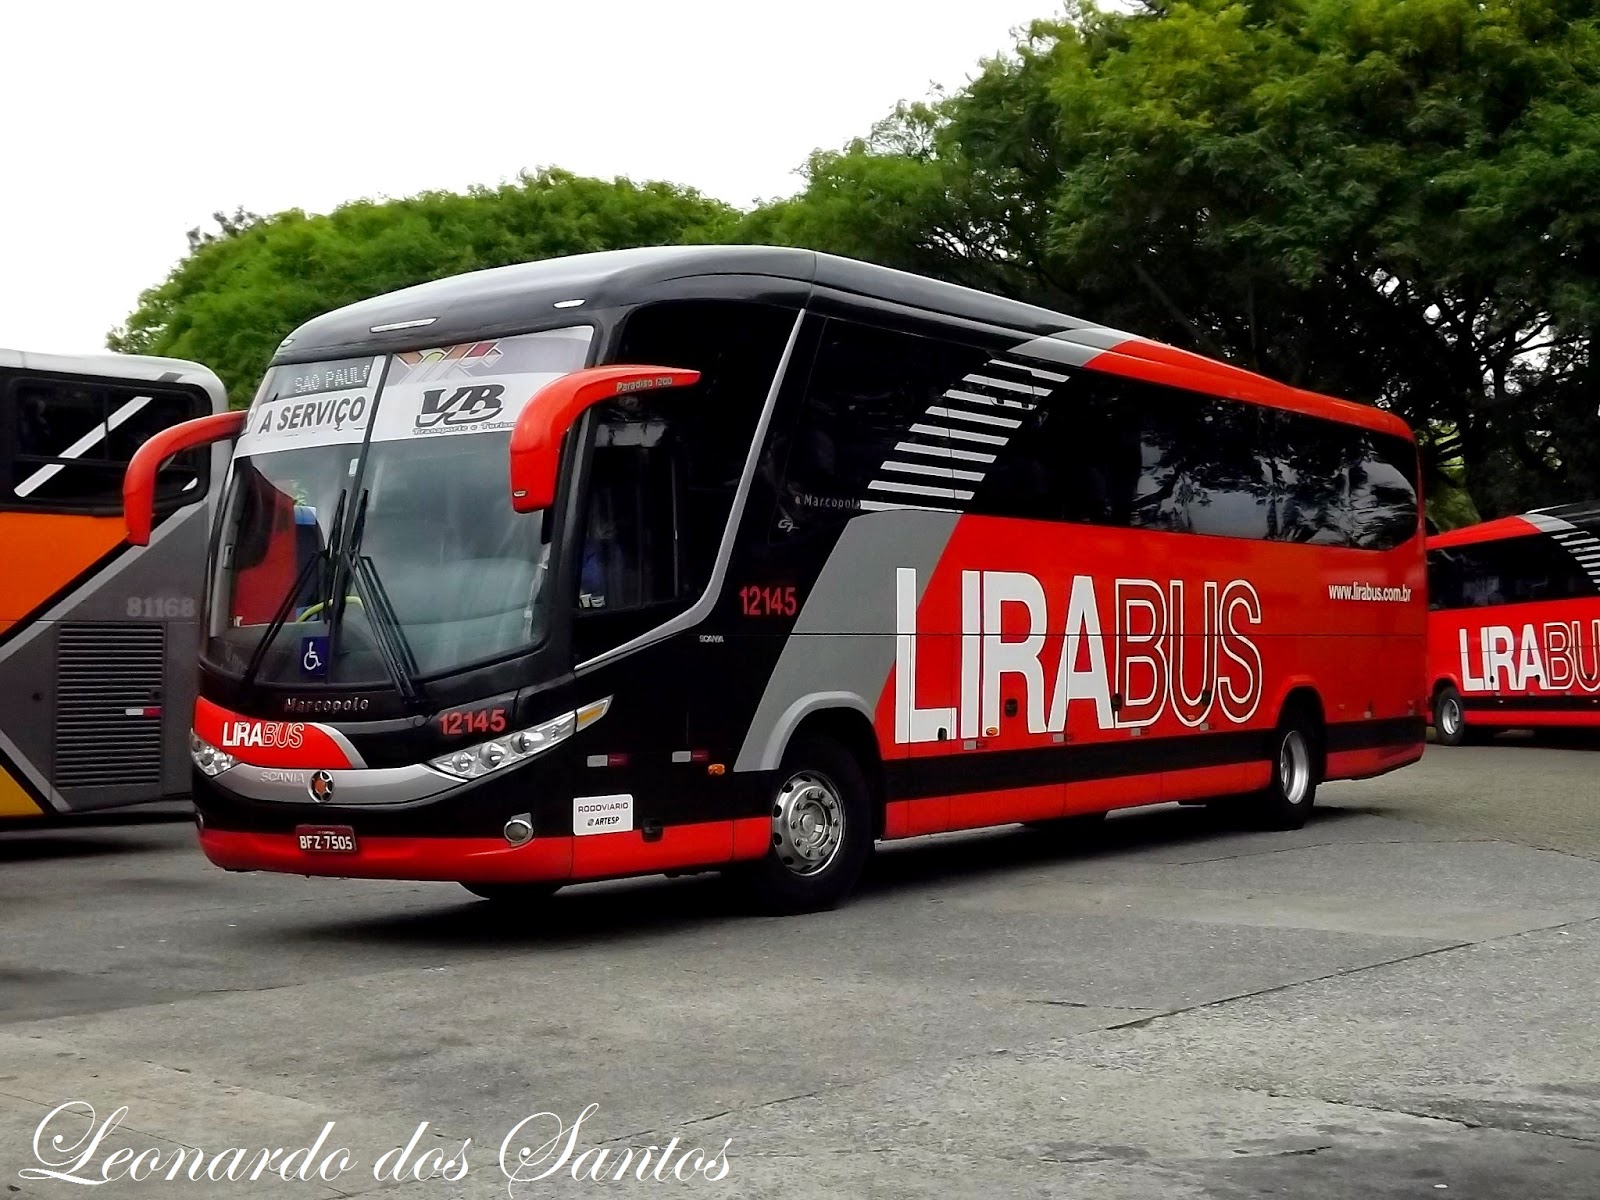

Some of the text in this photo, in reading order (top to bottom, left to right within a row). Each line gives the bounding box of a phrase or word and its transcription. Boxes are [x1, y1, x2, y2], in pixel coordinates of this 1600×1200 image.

[616, 377, 673, 392] Paradiso 1200
[258, 396, 366, 434] A SERVIÇO
[415, 384, 506, 428] VB
[480, 421, 516, 430] Turism
[740, 585, 797, 616] 12145
[1328, 581, 1412, 602] www.lirabus.com.br
[126, 597, 196, 617] 81168
[699, 635, 724, 643] SCANIA
[895, 568, 1262, 744] LIRABUS
[1458, 619, 1600, 692] LIRABU
[284, 697, 370, 714] Marcopolo
[439, 708, 506, 735] 12145
[222, 721, 305, 749] LIRABUS
[260, 771, 305, 784] SCANIA
[577, 802, 629, 813] RODOVIARIO
[594, 816, 620, 826] ARTESP
